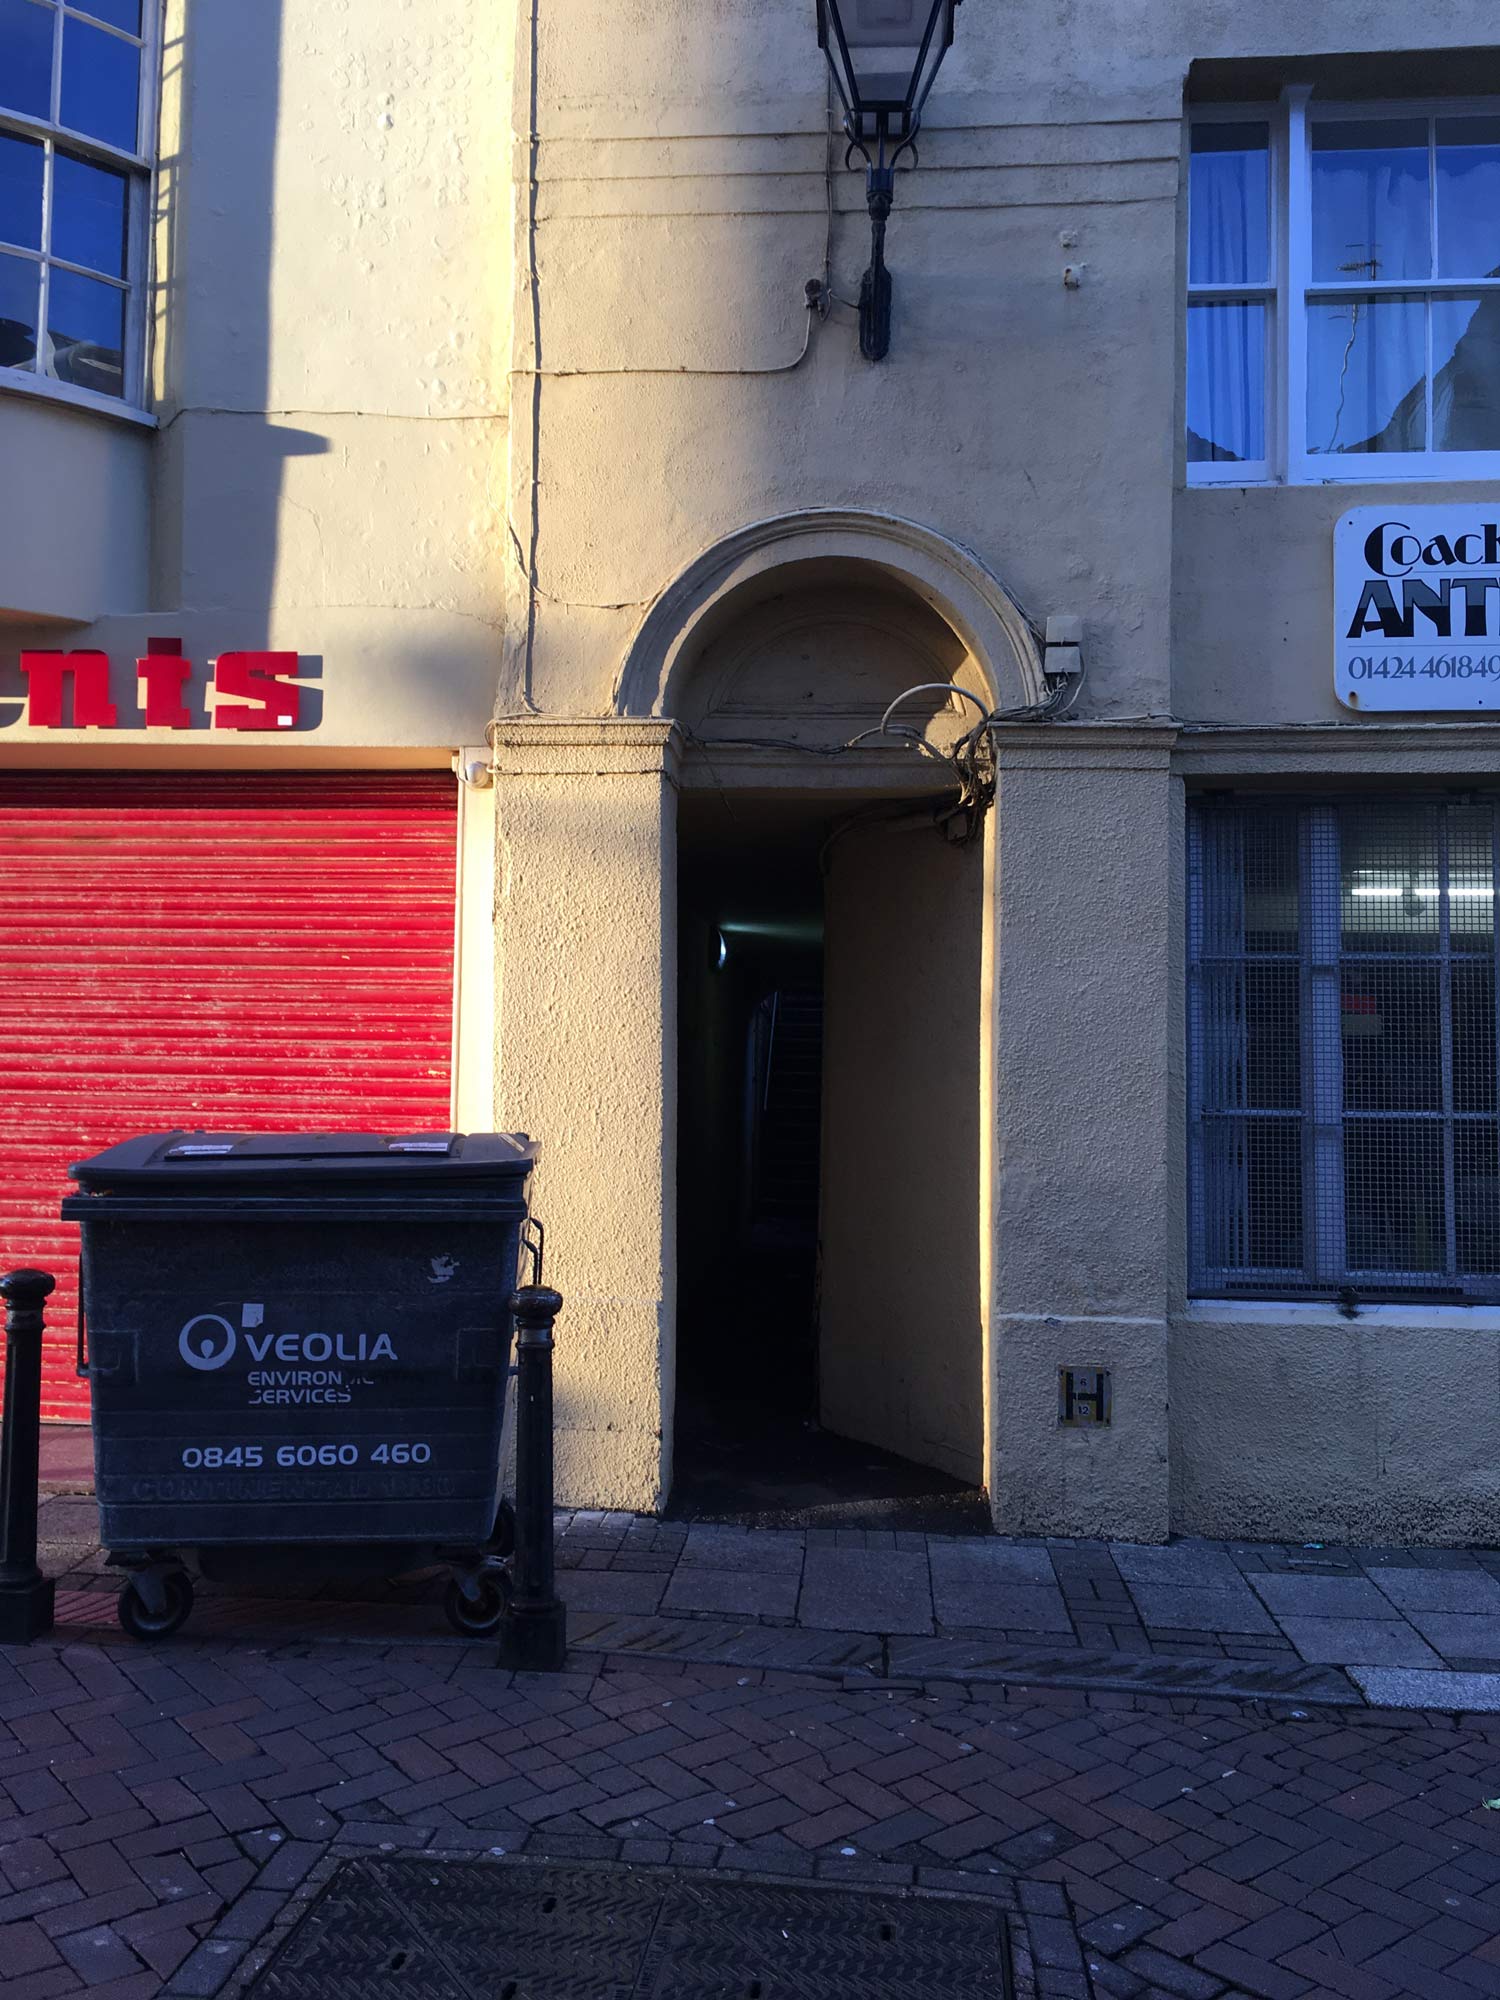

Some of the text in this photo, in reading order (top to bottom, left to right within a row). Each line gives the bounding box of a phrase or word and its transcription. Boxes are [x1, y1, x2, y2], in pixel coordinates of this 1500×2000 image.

[1346, 577, 1500, 638] ANT
[1348, 656, 1416, 679] 01424
[244, 1333, 399, 1361] VEOLIA
[1078, 1406, 1089, 1415] 12
[182, 1443, 431, 1468] 0845 6060 460
